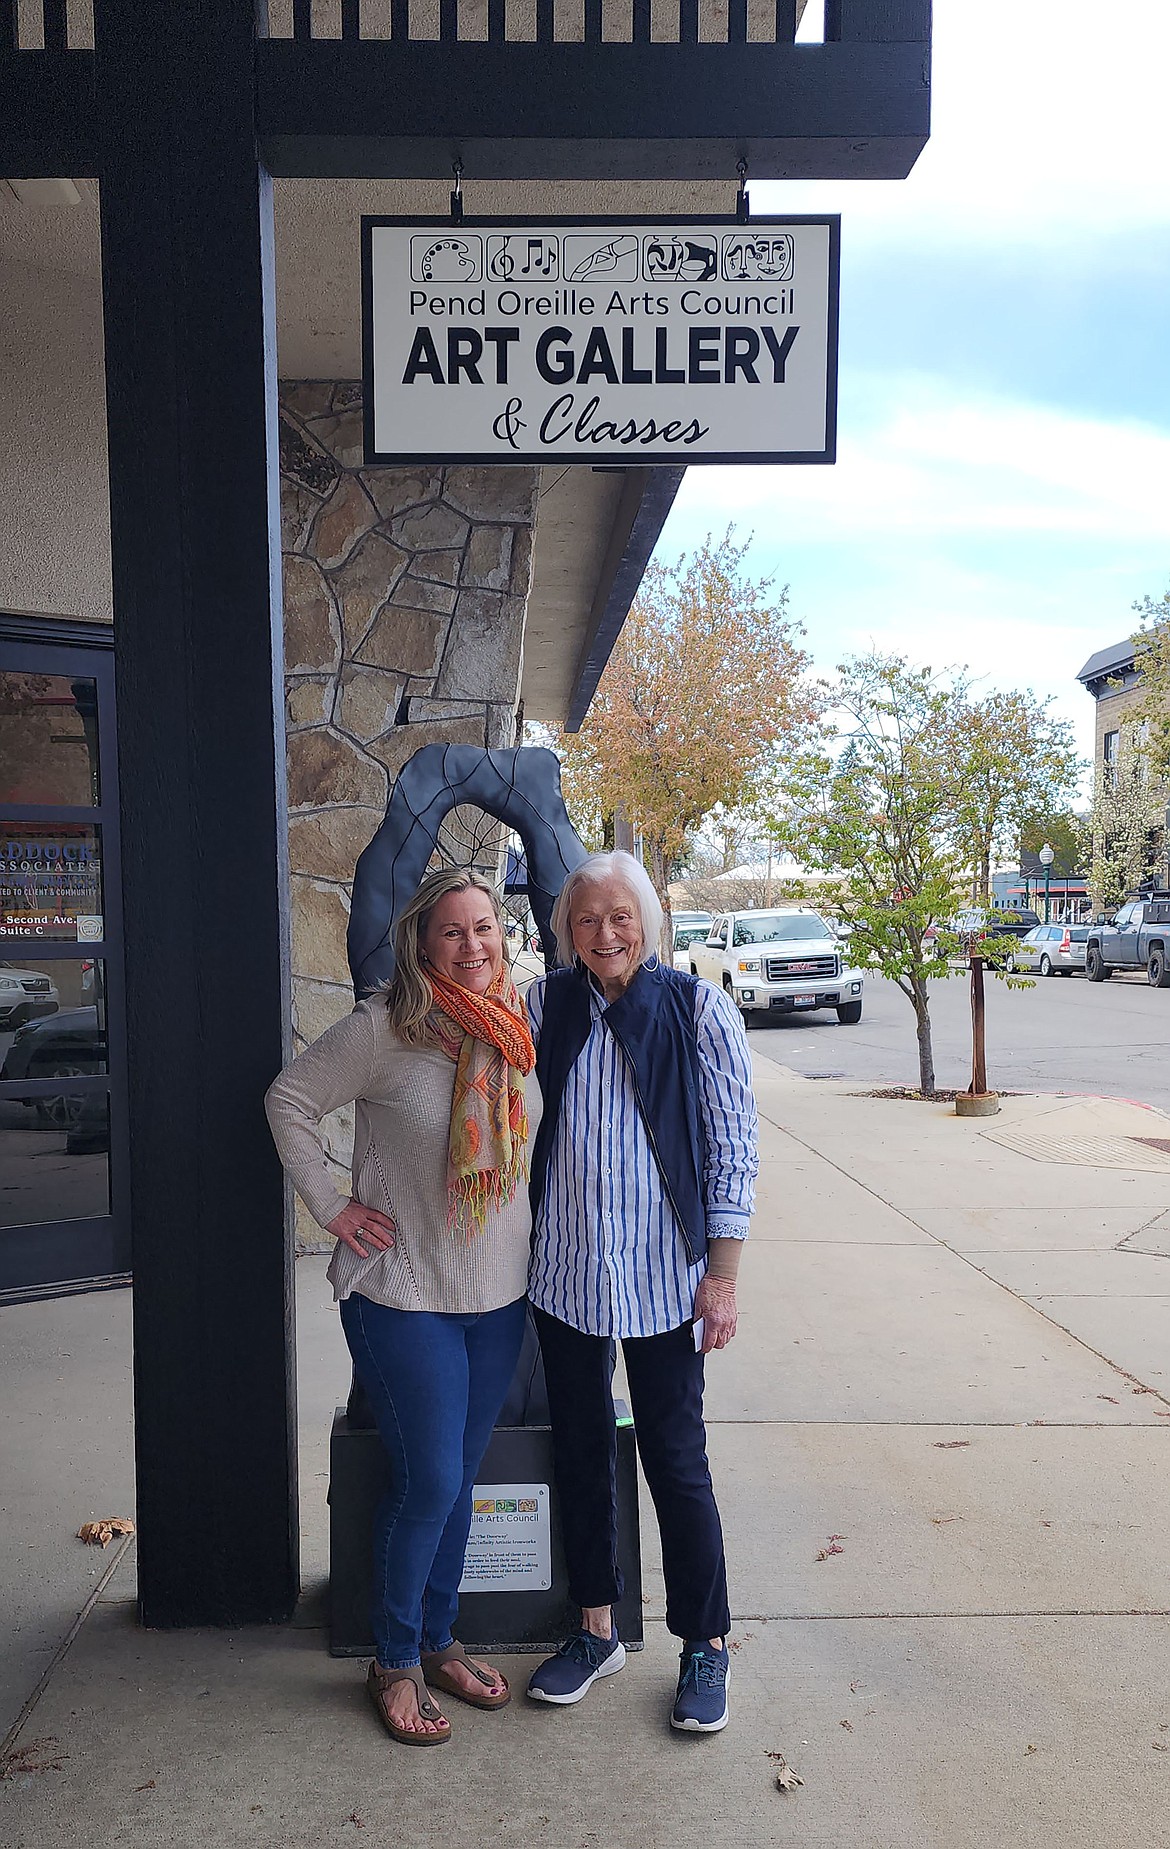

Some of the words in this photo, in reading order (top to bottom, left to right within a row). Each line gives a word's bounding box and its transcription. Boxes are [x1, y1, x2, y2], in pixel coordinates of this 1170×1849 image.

[409, 289, 486, 316] Pend
[497, 289, 595, 316] Oreille
[605, 290, 670, 316] Arts
[680, 288, 794, 316] Council
[402, 326, 520, 385] ART
[535, 325, 801, 385] GALLERY
[492, 397, 528, 450] &
[539, 393, 710, 445] Classes
[0, 841, 93, 861] DDOCK
[0, 860, 96, 872] SSOCIATES
[13, 888, 22, 896] TO
[24, 888, 48, 896] CLIENT
[56, 888, 97, 896] COMMUNITY
[6, 915, 48, 924] Second
[53, 915, 77, 924] Ave.
[0, 926, 31, 935] Suite
[35, 926, 44, 935] C
[486, 1514, 504, 1523] Arts
[506, 1513, 539, 1522] Council
